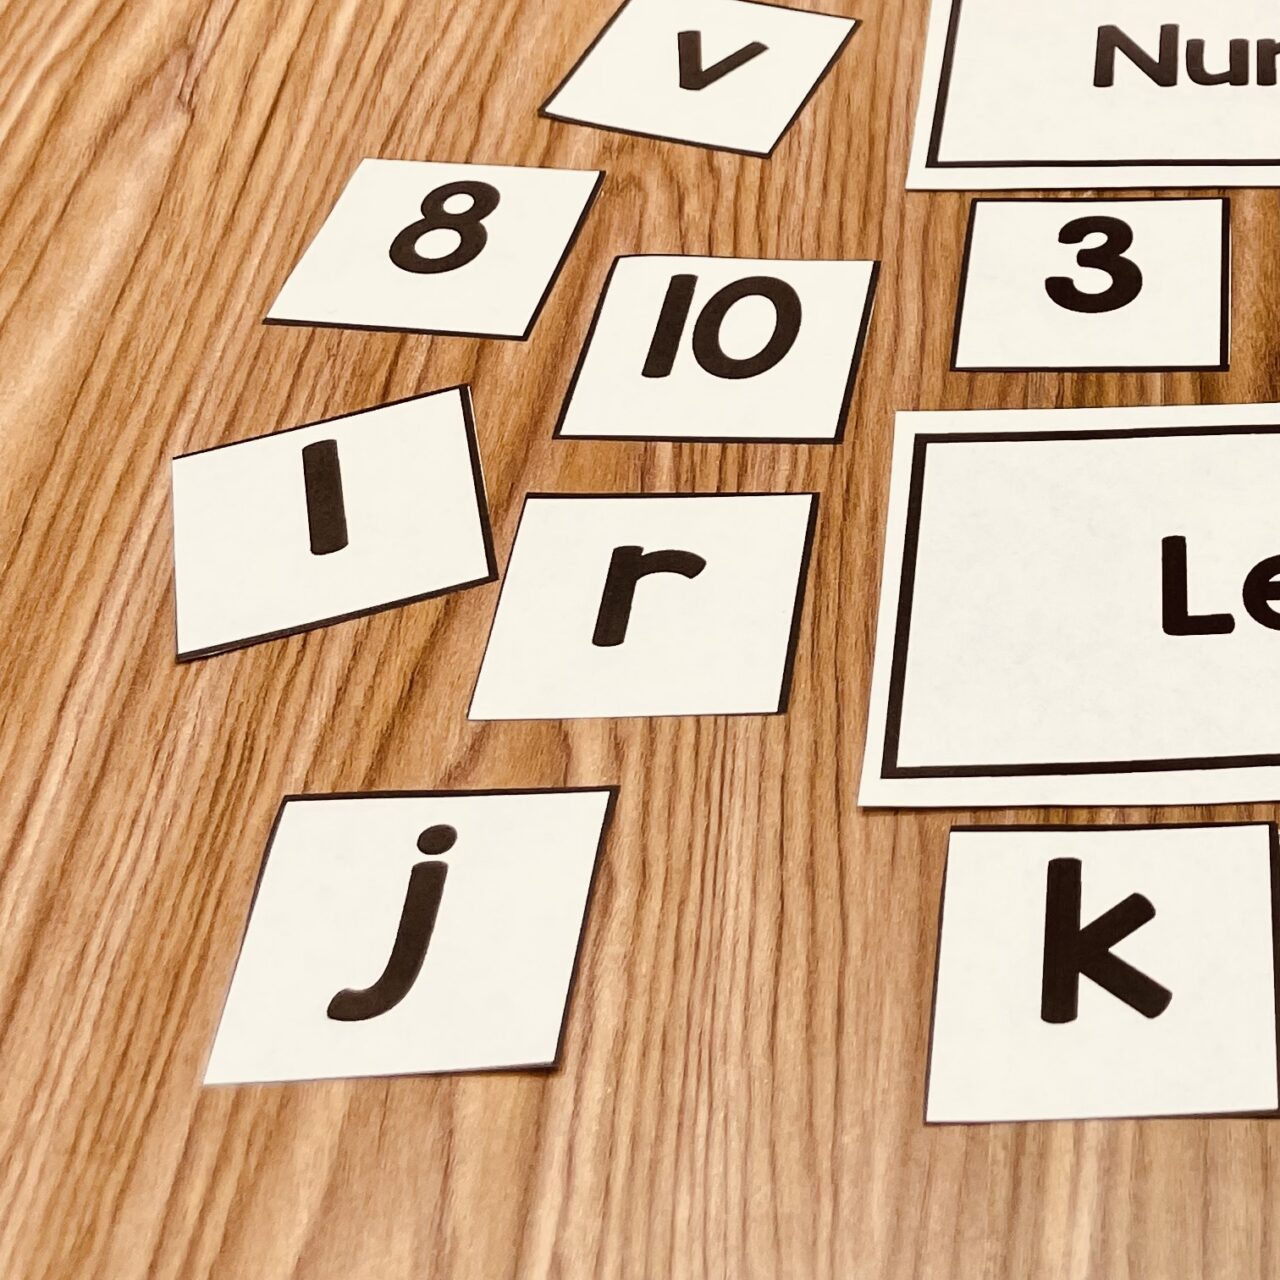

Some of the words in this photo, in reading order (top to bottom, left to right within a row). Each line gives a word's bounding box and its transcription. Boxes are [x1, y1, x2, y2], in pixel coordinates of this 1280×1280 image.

[677, 30, 768, 91] v
[388, 180, 500, 275] 8
[1044, 215, 1143, 314] 3
[641, 273, 802, 380] 10
[591, 545, 707, 648] r
[326, 824, 458, 1022] j
[1040, 857, 1173, 1024] k
